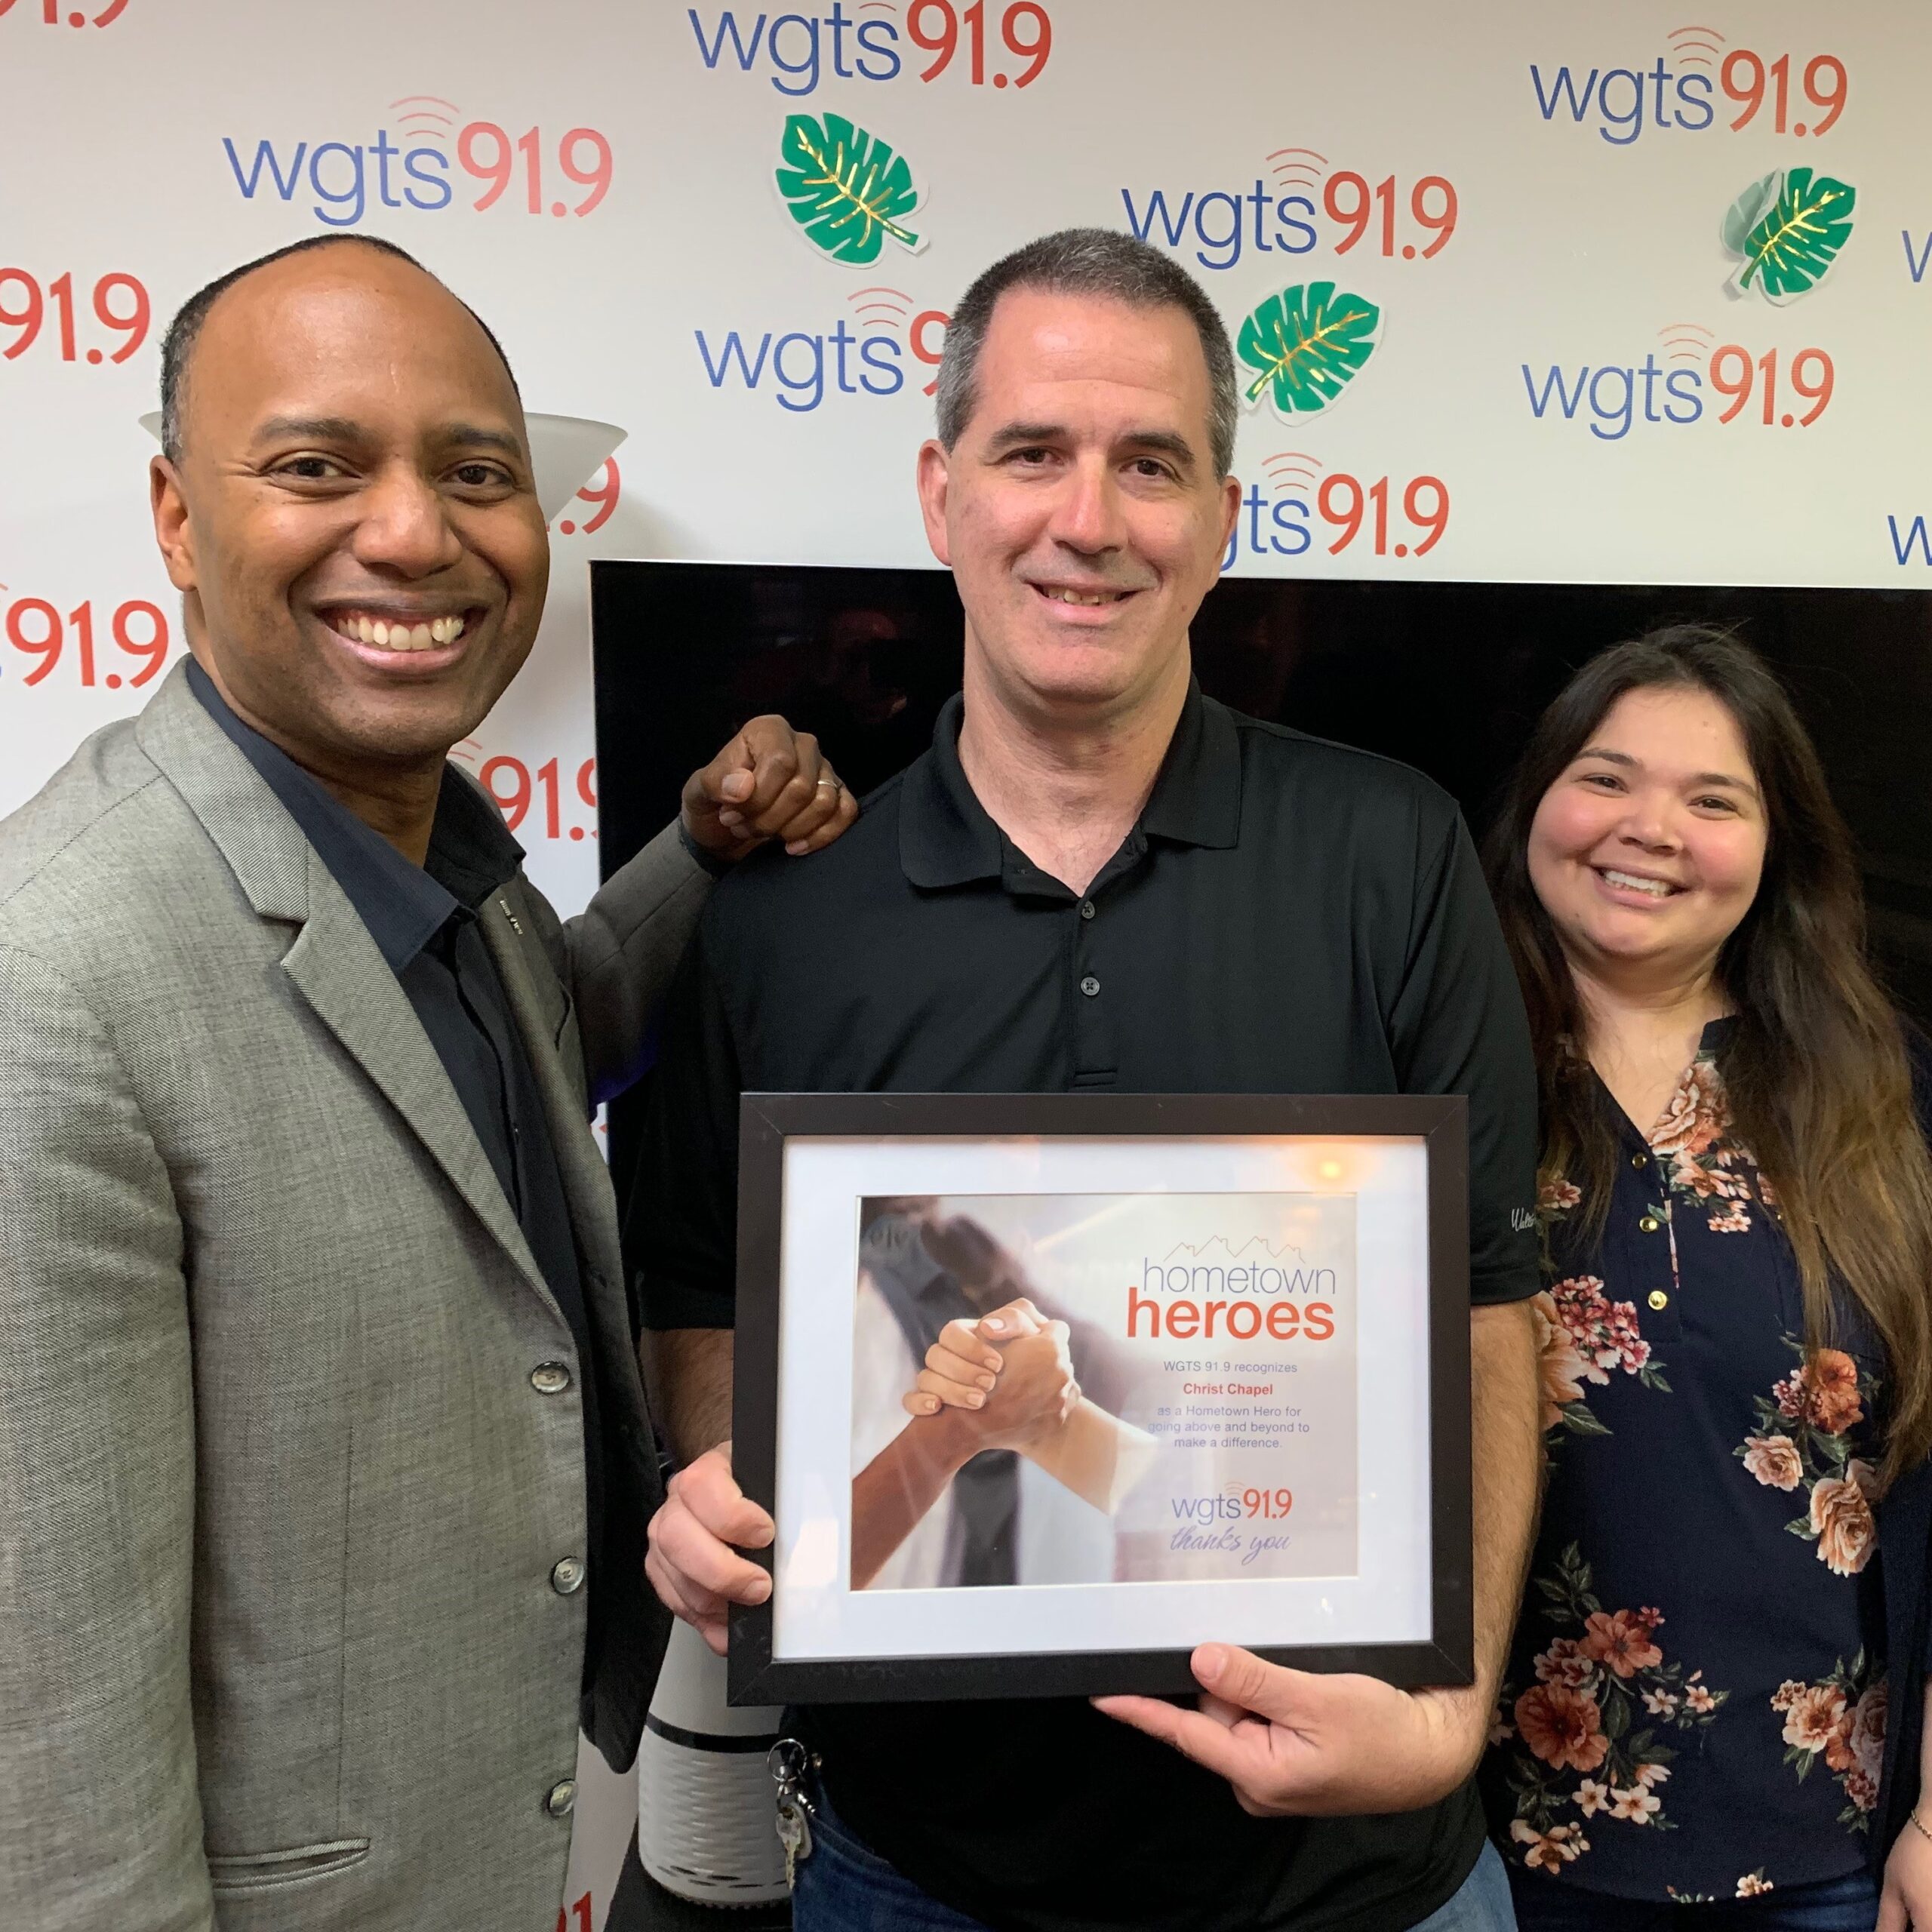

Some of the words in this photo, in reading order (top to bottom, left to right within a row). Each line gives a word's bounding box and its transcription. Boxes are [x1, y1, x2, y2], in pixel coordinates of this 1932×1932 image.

[1144, 1257, 1336, 1294] hometown
[1128, 1287, 1335, 1340] heroes
[1164, 1361, 1201, 1372] WGTS
[1204, 1361, 1230, 1372] 91.9
[1234, 1362, 1298, 1374] recognizes
[1183, 1383, 1223, 1395] Christ
[1227, 1383, 1273, 1397] Chapel
[1157, 1407, 1171, 1416] as
[1174, 1407, 1182, 1416] a
[1186, 1405, 1250, 1417] Hometown
[1254, 1406, 1281, 1417] Hero
[1285, 1406, 1302, 1417] for
[1148, 1422, 1181, 1433] going
[1185, 1421, 1221, 1432] above
[1225, 1422, 1247, 1432] and
[1251, 1422, 1294, 1434] beyond
[1298, 1423, 1310, 1432] to
[1174, 1437, 1206, 1447] make
[1210, 1439, 1217, 1447] a
[1221, 1437, 1283, 1448] difference.
[1170, 1525, 1241, 1551] thanks
[1241, 1536, 1291, 1565] you
